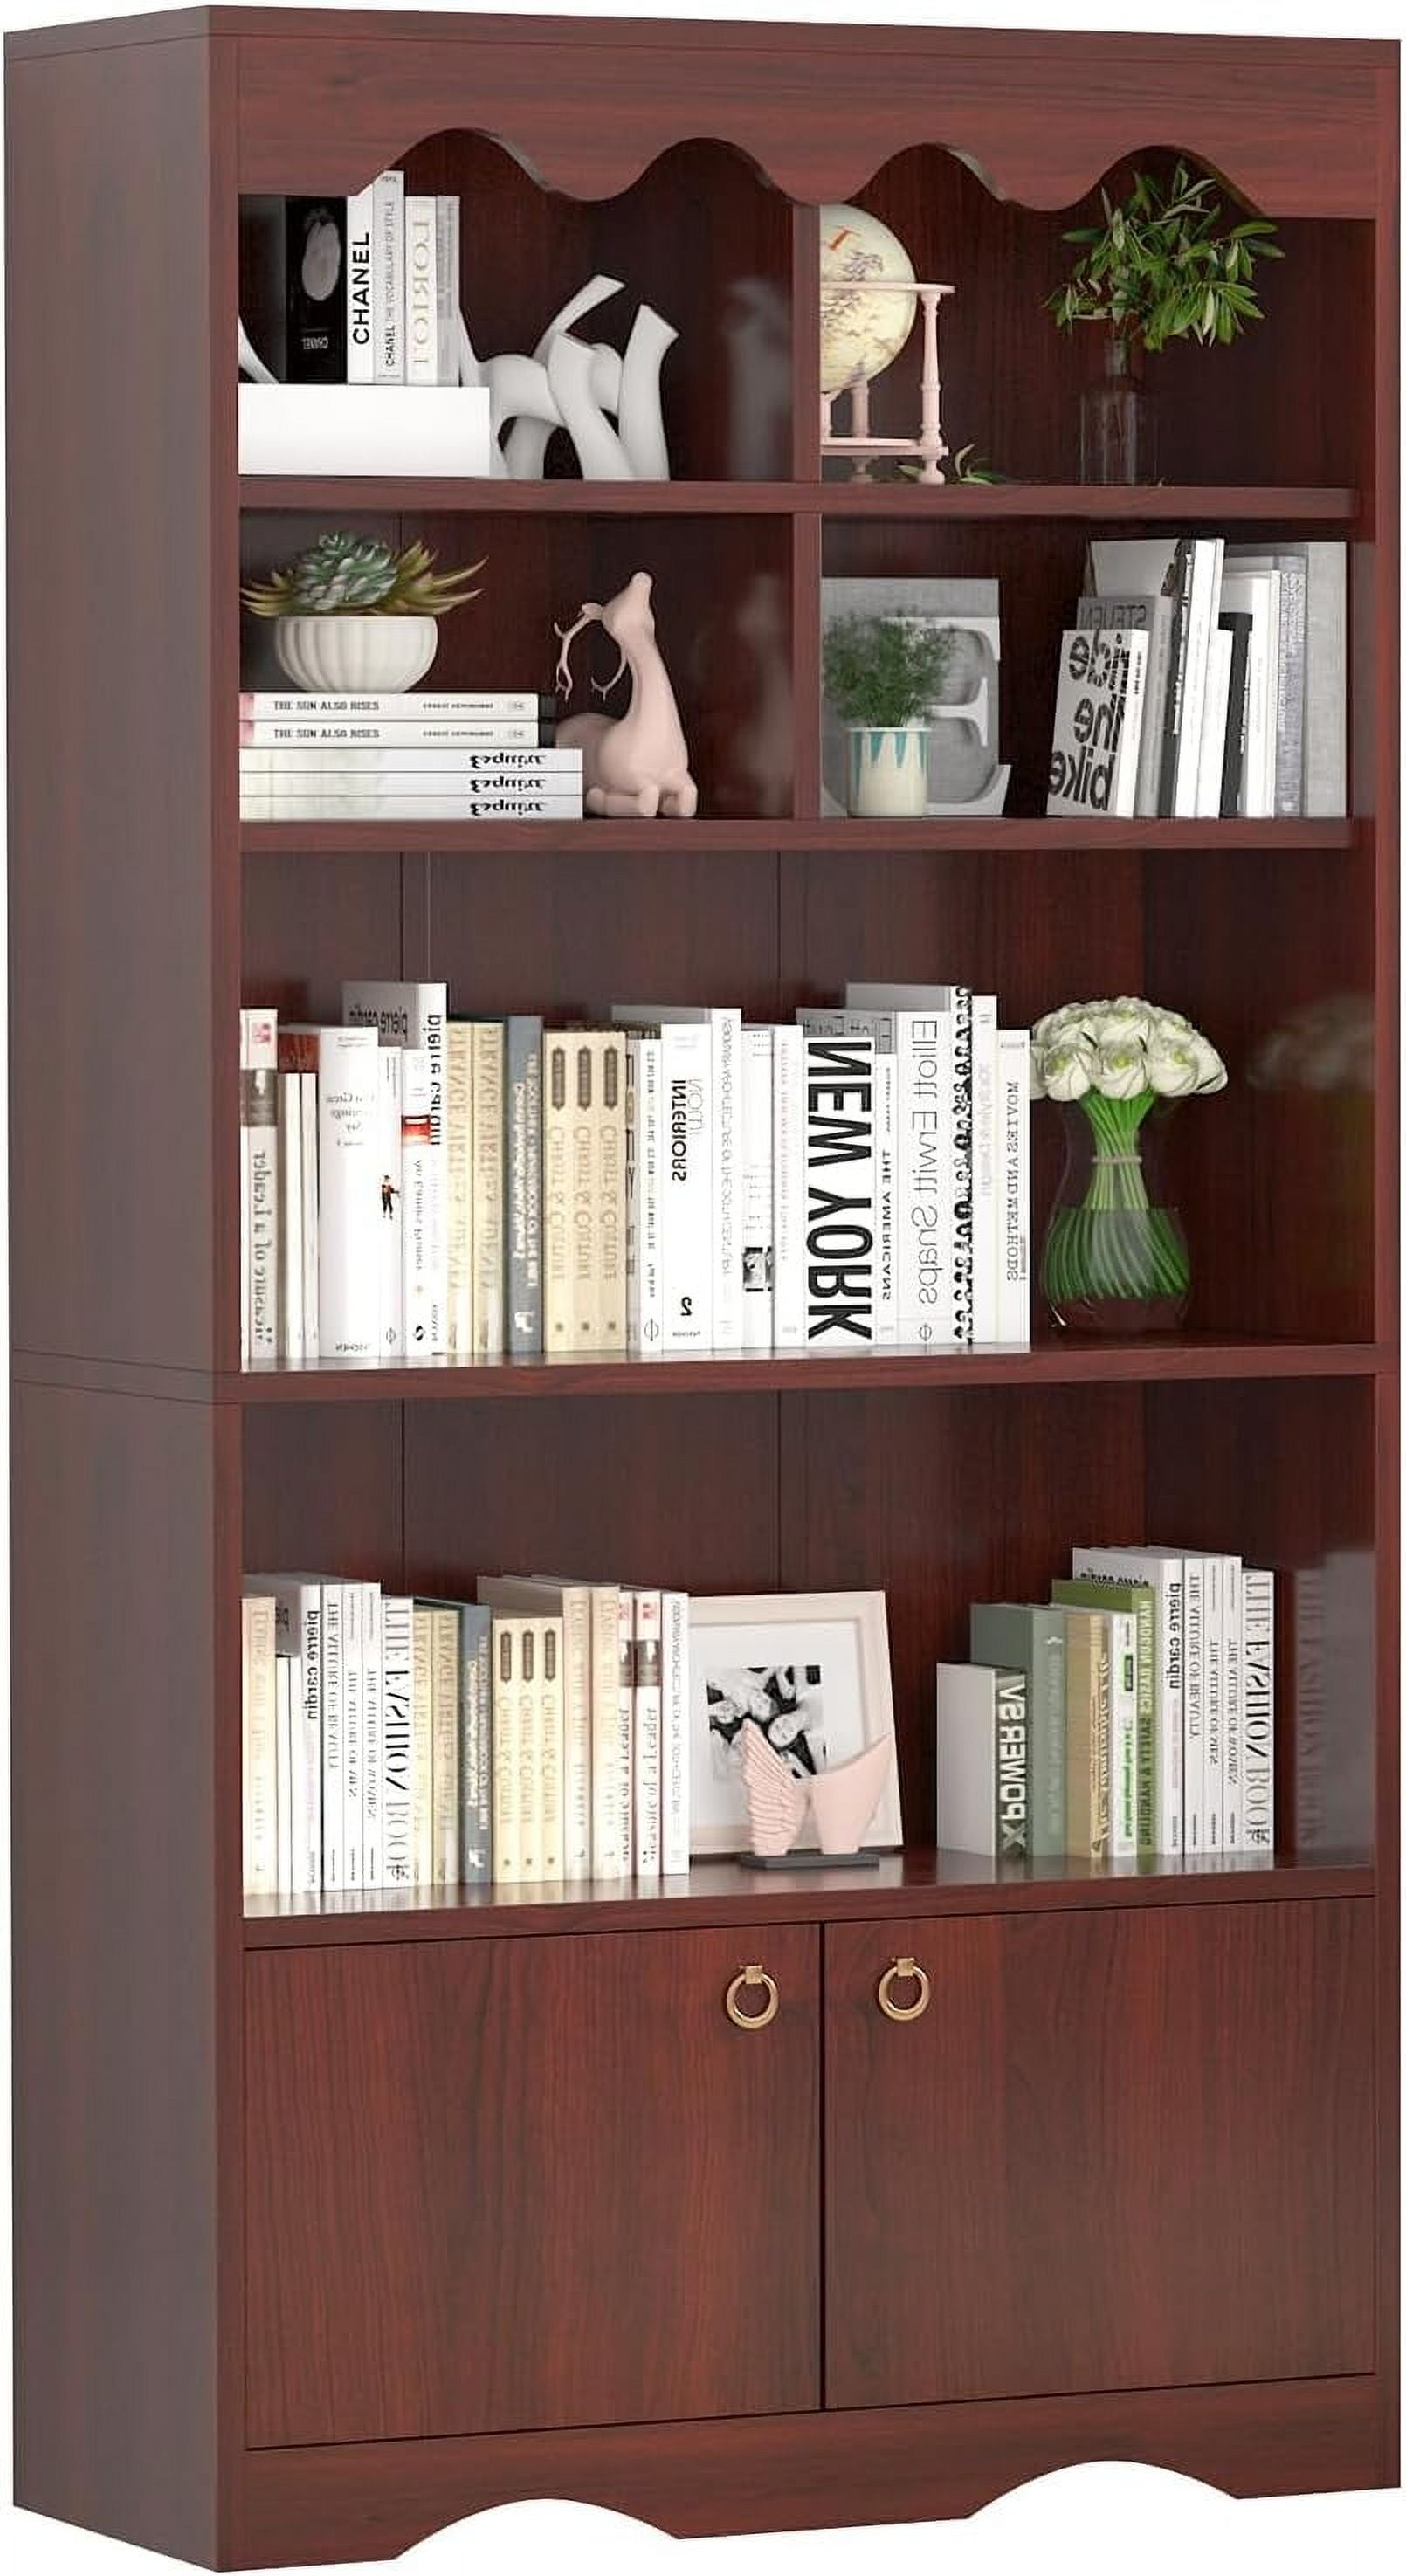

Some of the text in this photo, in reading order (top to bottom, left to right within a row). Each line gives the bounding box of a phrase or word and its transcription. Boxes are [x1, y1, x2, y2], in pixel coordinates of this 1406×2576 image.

[352, 232, 369, 344] CHANEL
[385, 326, 395, 366] CHANEL
[274, 701, 379, 711] THE SUN ALSO RISES
[274, 729, 379, 739] THE SUN ALSO RISES
[642, 1706, 657, 1759] Leader
[642, 1781, 657, 1795] of
[642, 1803, 657, 1863] Measure
